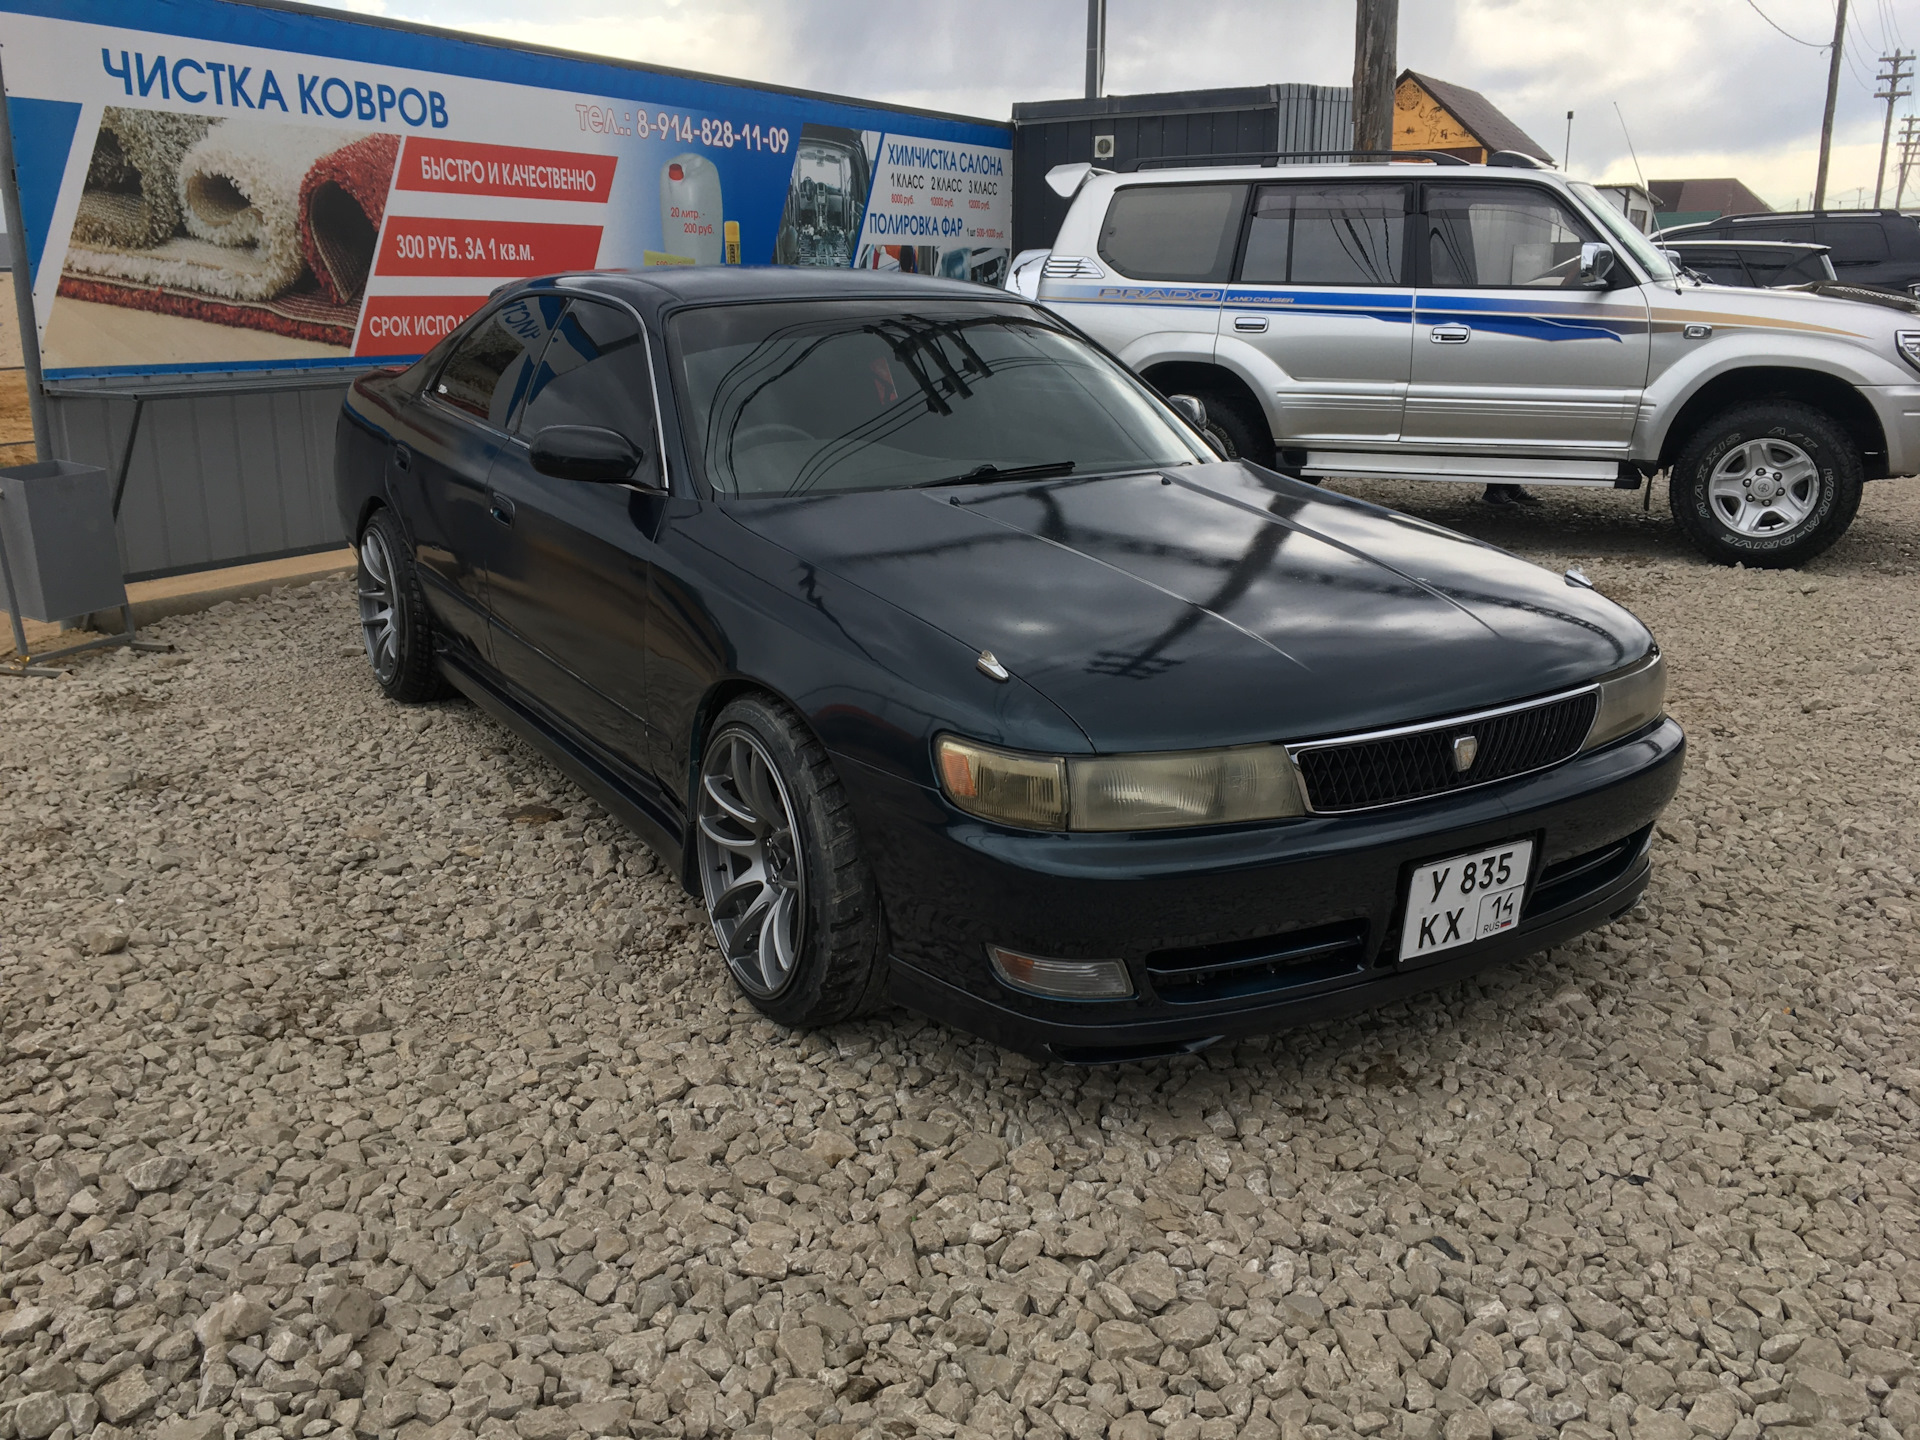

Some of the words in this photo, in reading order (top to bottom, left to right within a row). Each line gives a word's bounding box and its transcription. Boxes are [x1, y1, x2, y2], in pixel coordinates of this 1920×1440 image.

[101, 47, 289, 113] ЧИСТКА
[297, 73, 449, 129] КОВРОВ
[575, 103, 632, 137] тел.:
[636, 108, 790, 154] 8-914-828-11-09
[887, 143, 958, 172] ХИМЧИСТКА
[959, 152, 1004, 176] САЛОНА
[420, 155, 485, 184] БЫСТРО
[487, 161, 500, 185] И
[501, 162, 597, 192] КАЧЕСТВЕННО
[890, 172, 896, 188] 1
[896, 173, 925, 190] КЛАСС
[931, 176, 936, 191] 2
[936, 176, 963, 193] КЛАСС
[968, 180, 973, 194] 3
[973, 181, 998, 196] КЛАСС
[670, 206, 680, 218] 20
[681, 210, 701, 220] литр.
[869, 213, 940, 237] ПОЛИРОВКА
[941, 216, 963, 238] ФАР
[684, 222, 697, 234] 200
[698, 223, 715, 236] руб.
[396, 234, 424, 259] 300
[427, 235, 463, 260] РУБ.
[464, 237, 486, 260] ЗА
[488, 238, 496, 260] 1
[1099, 288, 1221, 301] PRADO
[1253, 296, 1296, 304] CRUISER
[369, 316, 412, 337] СРОК
[1768, 426, 1819, 450] A/T
[1694, 432, 1742, 519] MAXXIS
[1720, 467, 1836, 550] WORM-DRIVE
[1460, 851, 1513, 895] 835
[1491, 892, 1514, 920] 14
[1482, 920, 1501, 935] RUS
